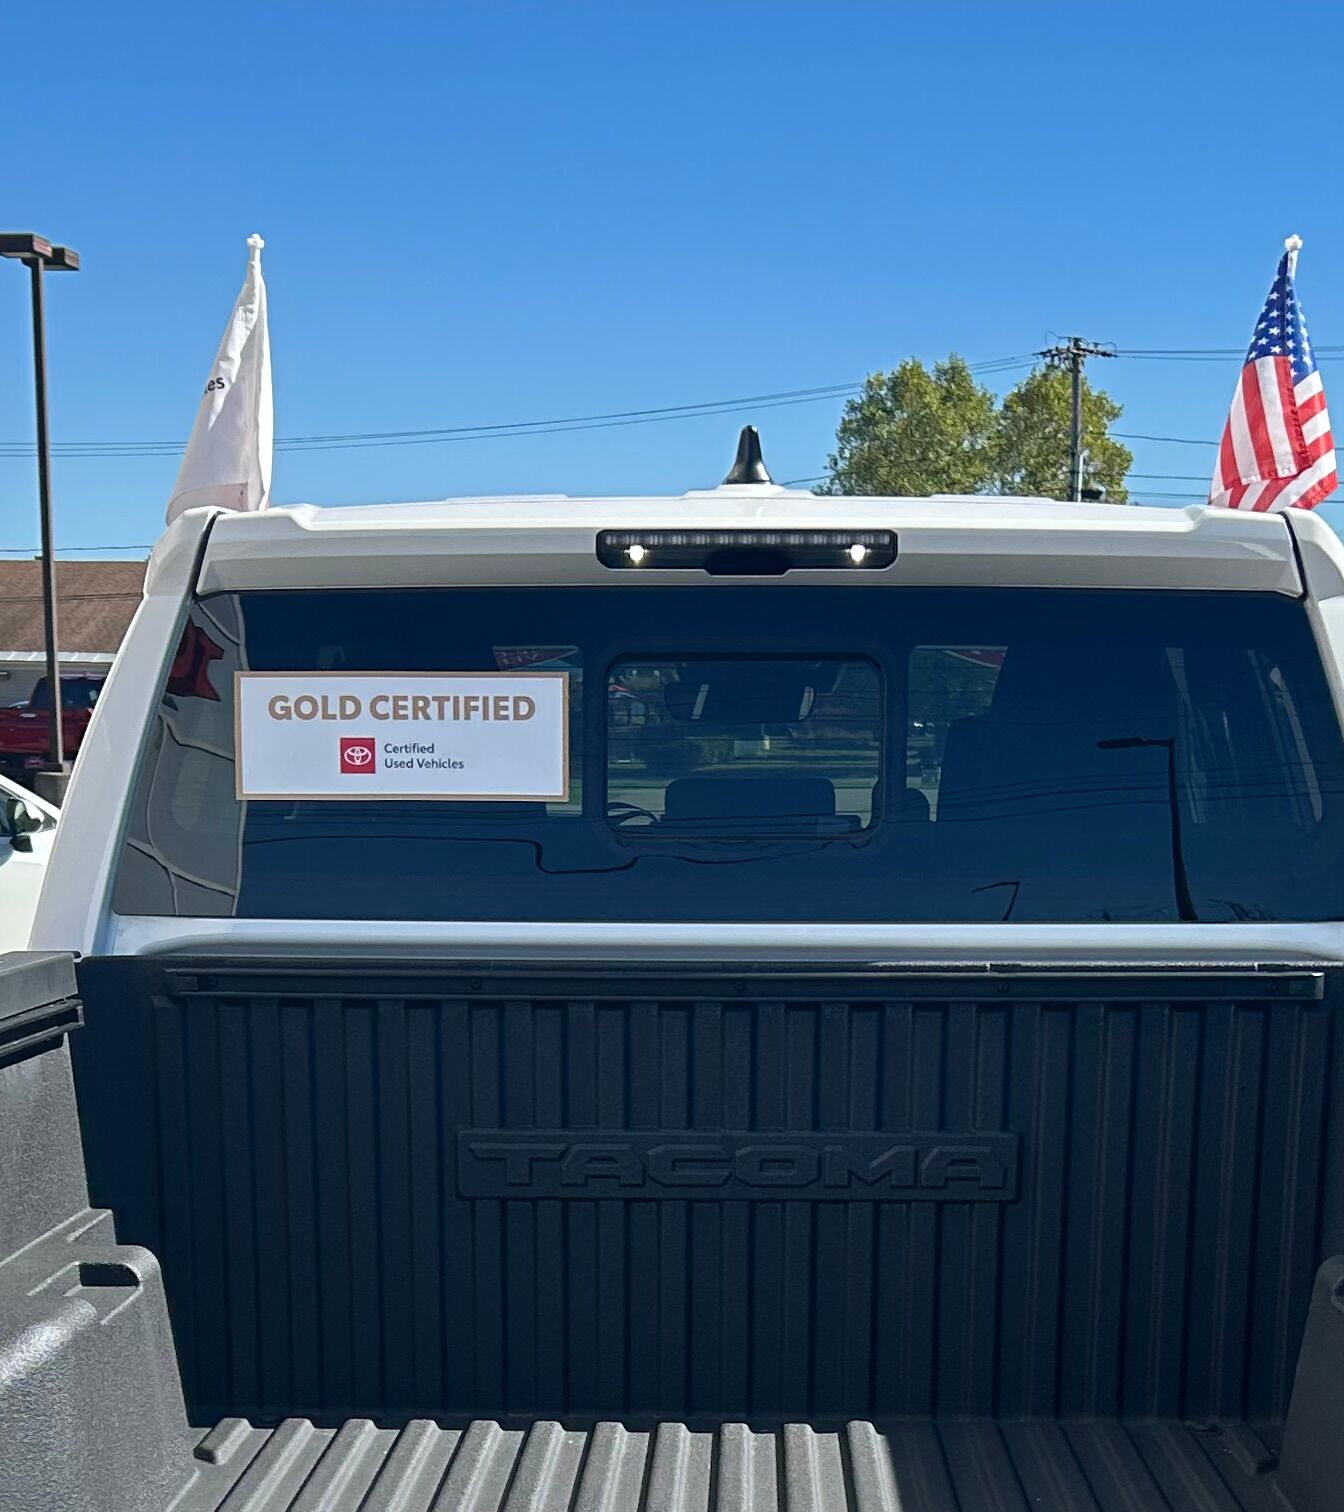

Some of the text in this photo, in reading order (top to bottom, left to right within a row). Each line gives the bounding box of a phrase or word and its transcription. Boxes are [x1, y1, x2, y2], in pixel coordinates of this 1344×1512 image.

[267, 694, 536, 721] GOLD CERTIFIED
[383, 742, 435, 754] Certified
[383, 758, 465, 770] Used Vehicles
[468, 1141, 1008, 1190] TACOMA
